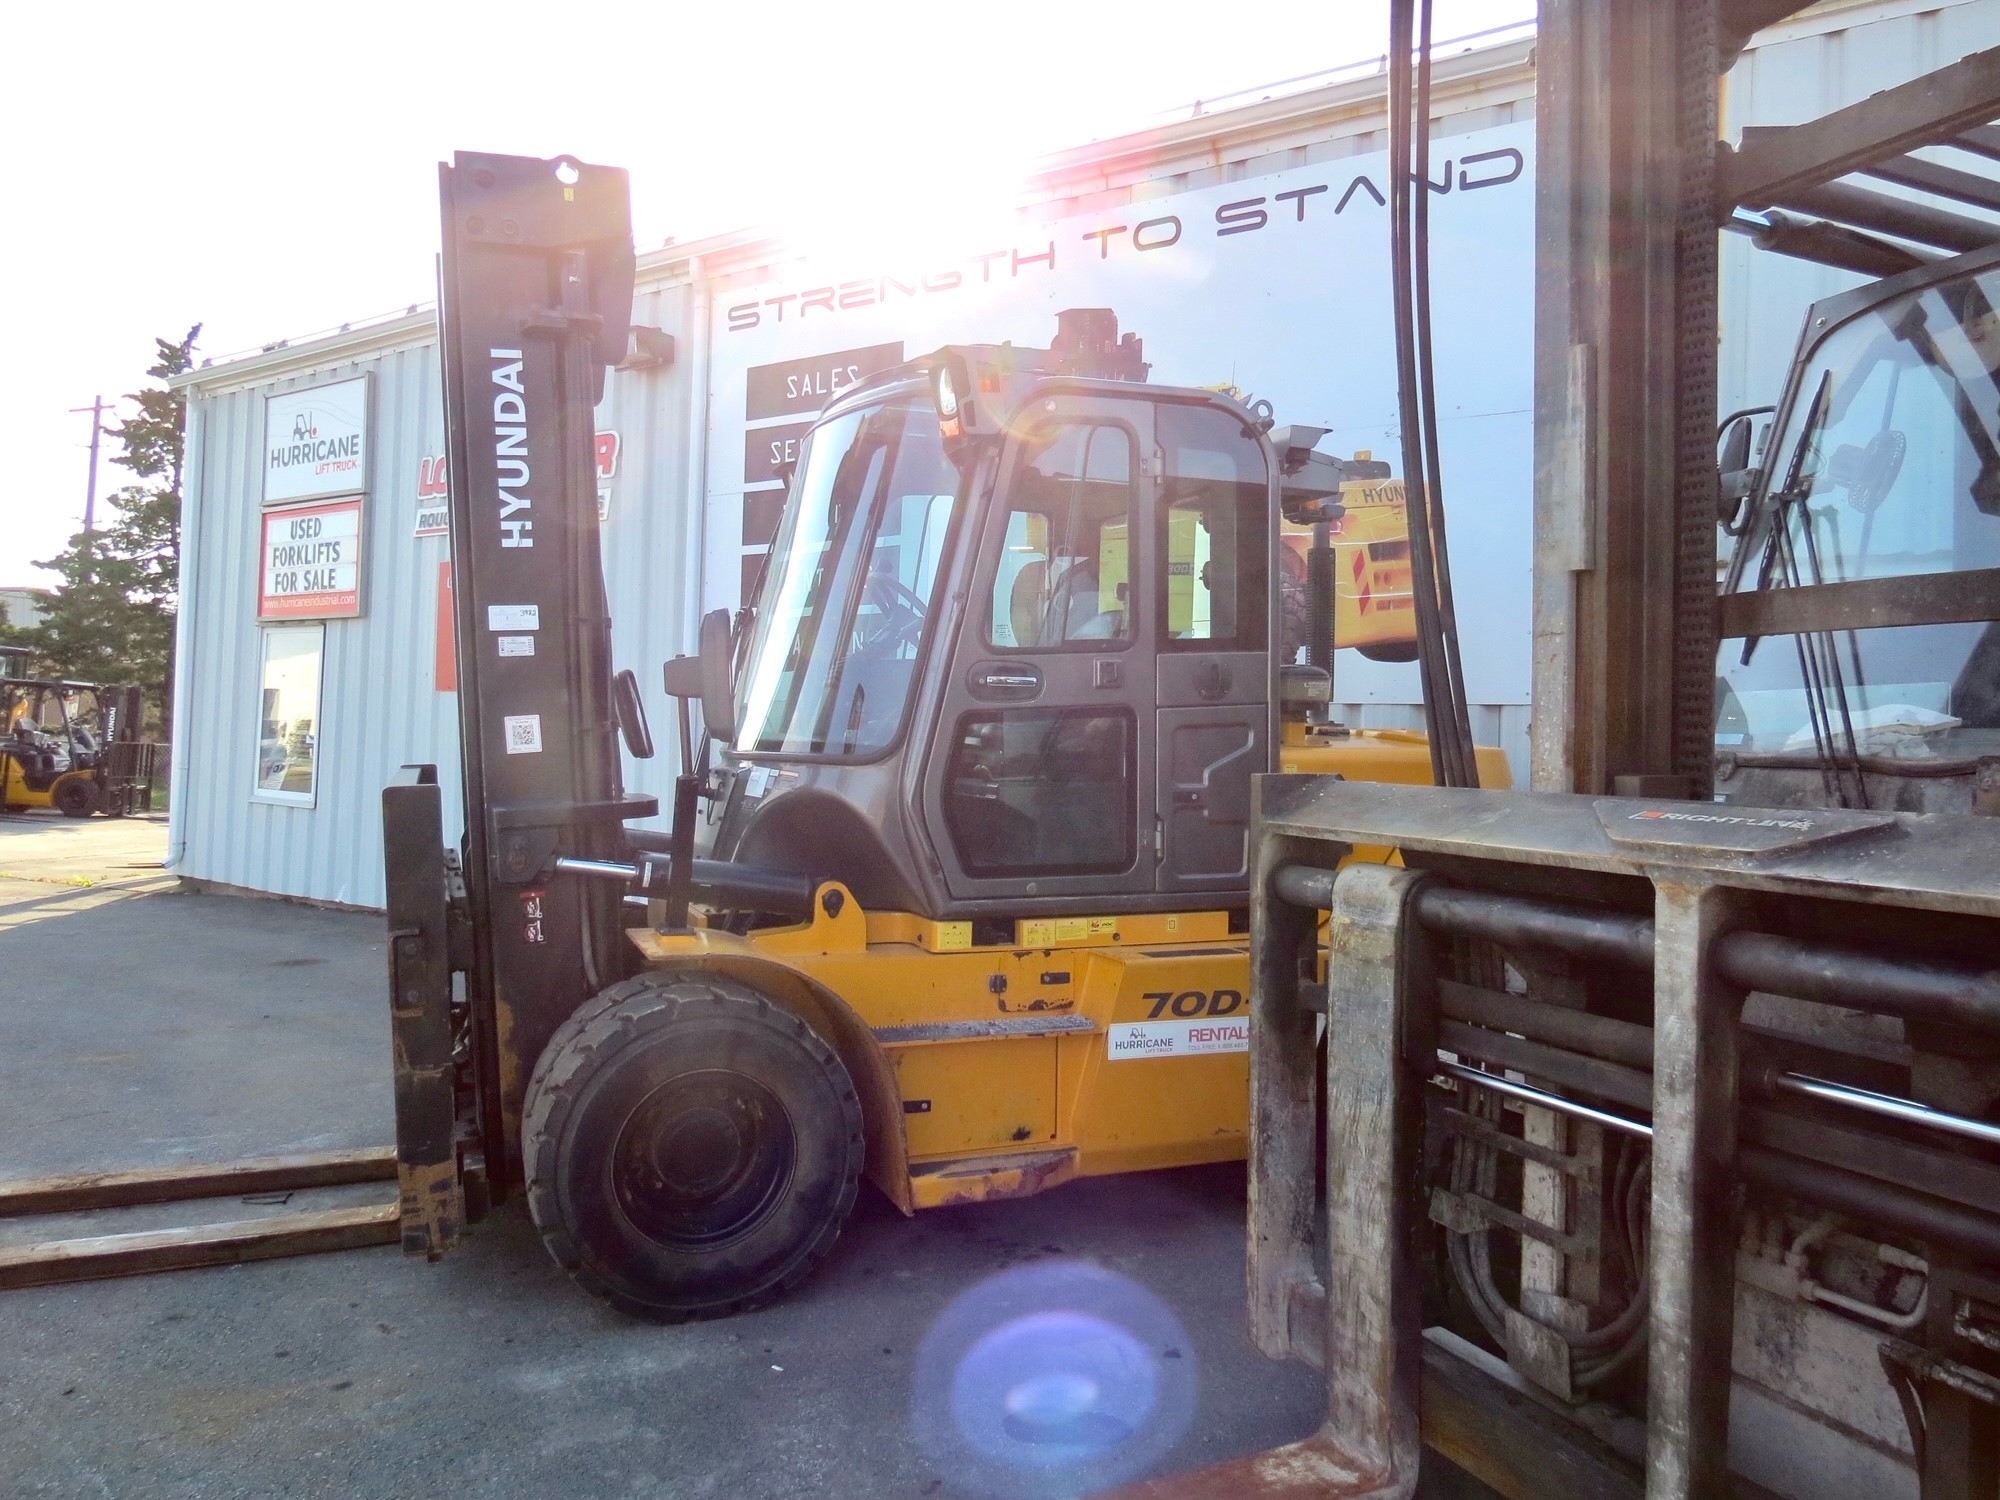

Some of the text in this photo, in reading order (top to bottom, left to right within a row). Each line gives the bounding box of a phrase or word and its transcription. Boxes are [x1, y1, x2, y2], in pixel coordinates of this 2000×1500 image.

[728, 241, 1054, 332] STRENGTH
[1082, 215, 1182, 260] TO
[786, 365, 859, 399] SALES
[271, 434, 360, 469] HURRICANE
[490, 348, 534, 548] HYUNDAI
[315, 459, 358, 476] LIFT TRUCK
[1362, 485, 1407, 504] HYUN
[290, 517, 322, 541] USED
[272, 540, 341, 568] FORKLIFTS
[274, 568, 337, 594] FOR SALE
[107, 707, 117, 742] HYUNDAI
[1115, 1037, 1174, 1050] HURRICANE
